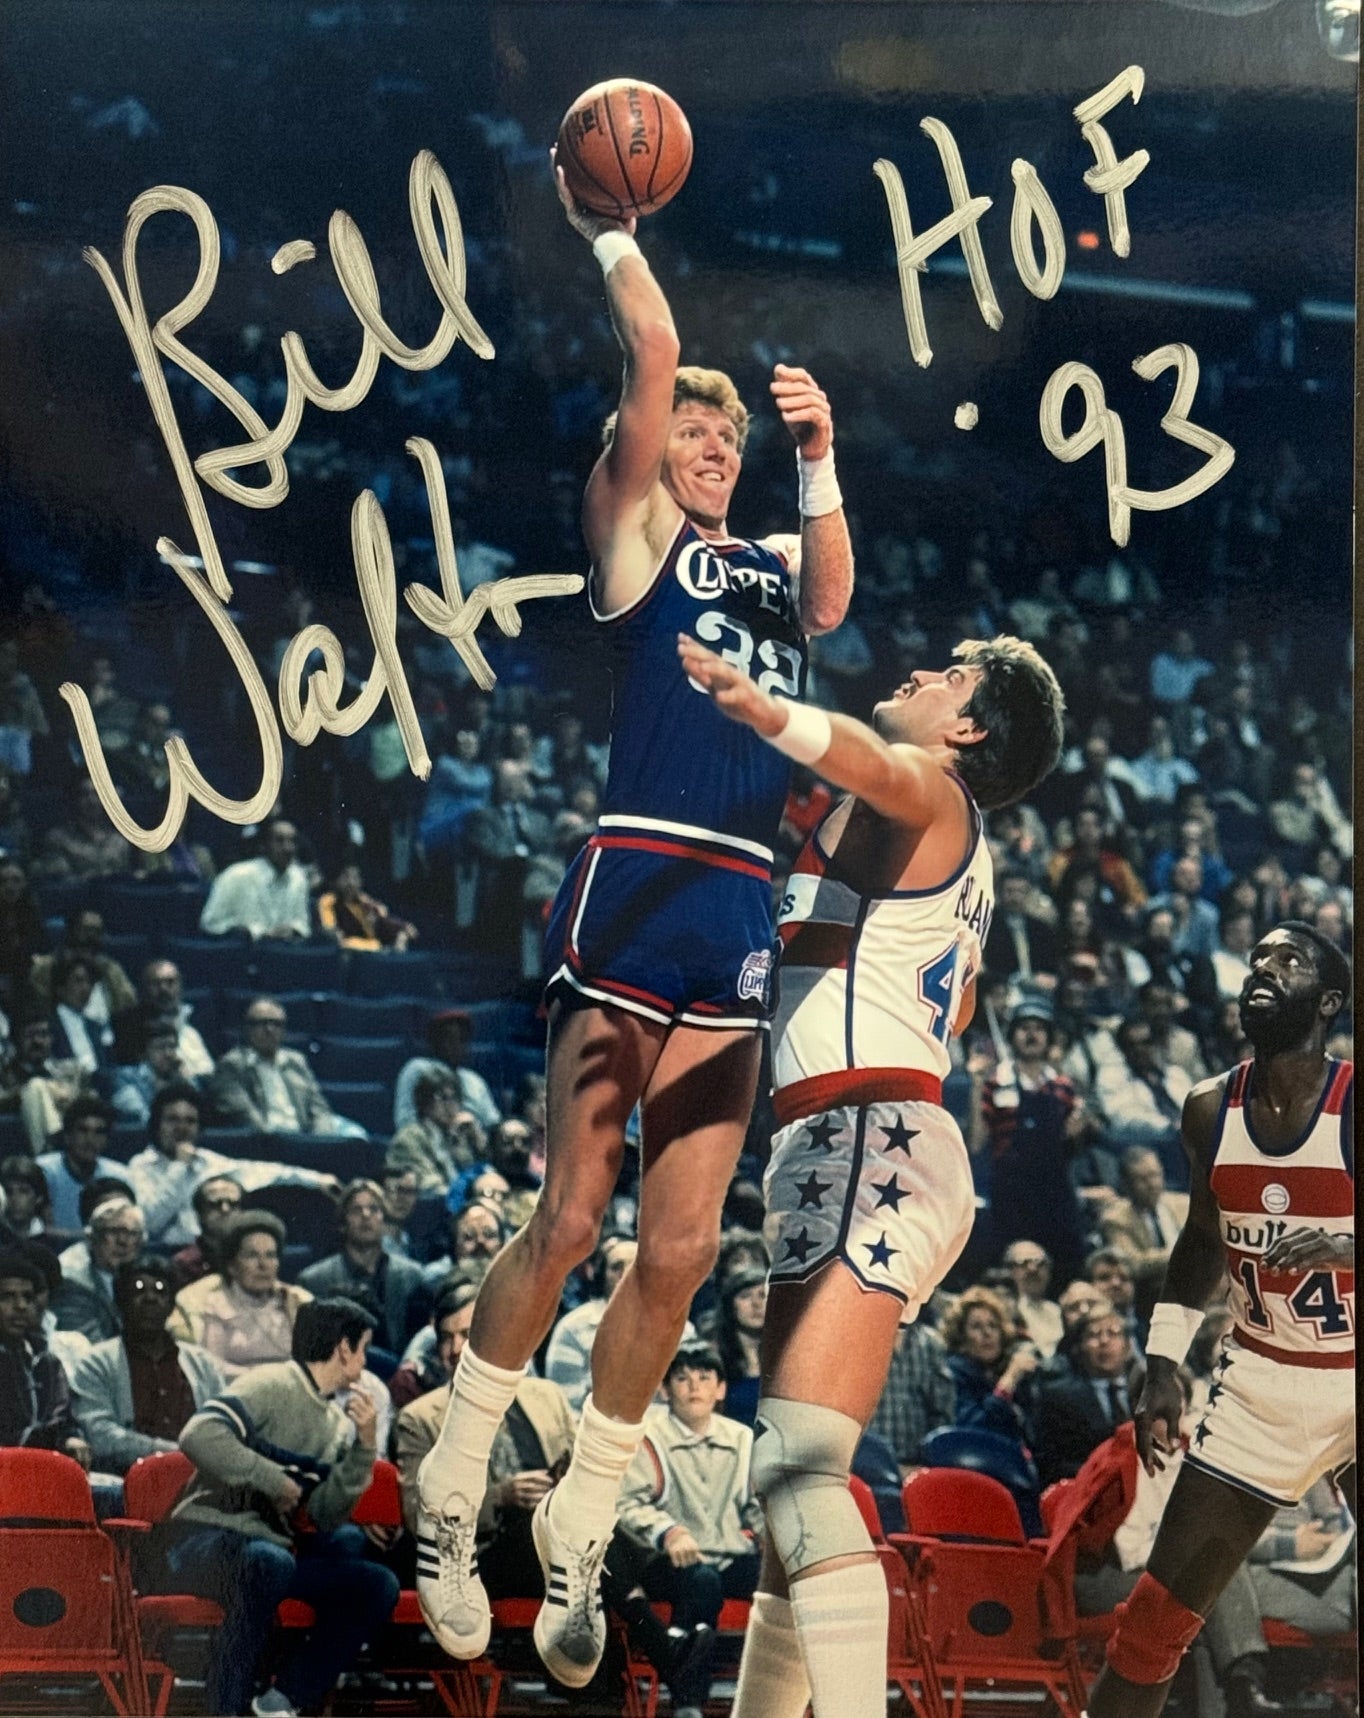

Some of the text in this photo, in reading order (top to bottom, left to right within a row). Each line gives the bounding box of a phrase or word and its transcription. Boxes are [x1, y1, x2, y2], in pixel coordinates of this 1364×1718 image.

[873, 65, 1150, 368] HOF
[83, 149, 496, 602] Bill
[676, 541, 793, 622] CLIPPE
[918, 938, 975, 1047] 4
[1239, 1257, 1353, 1341] 14
